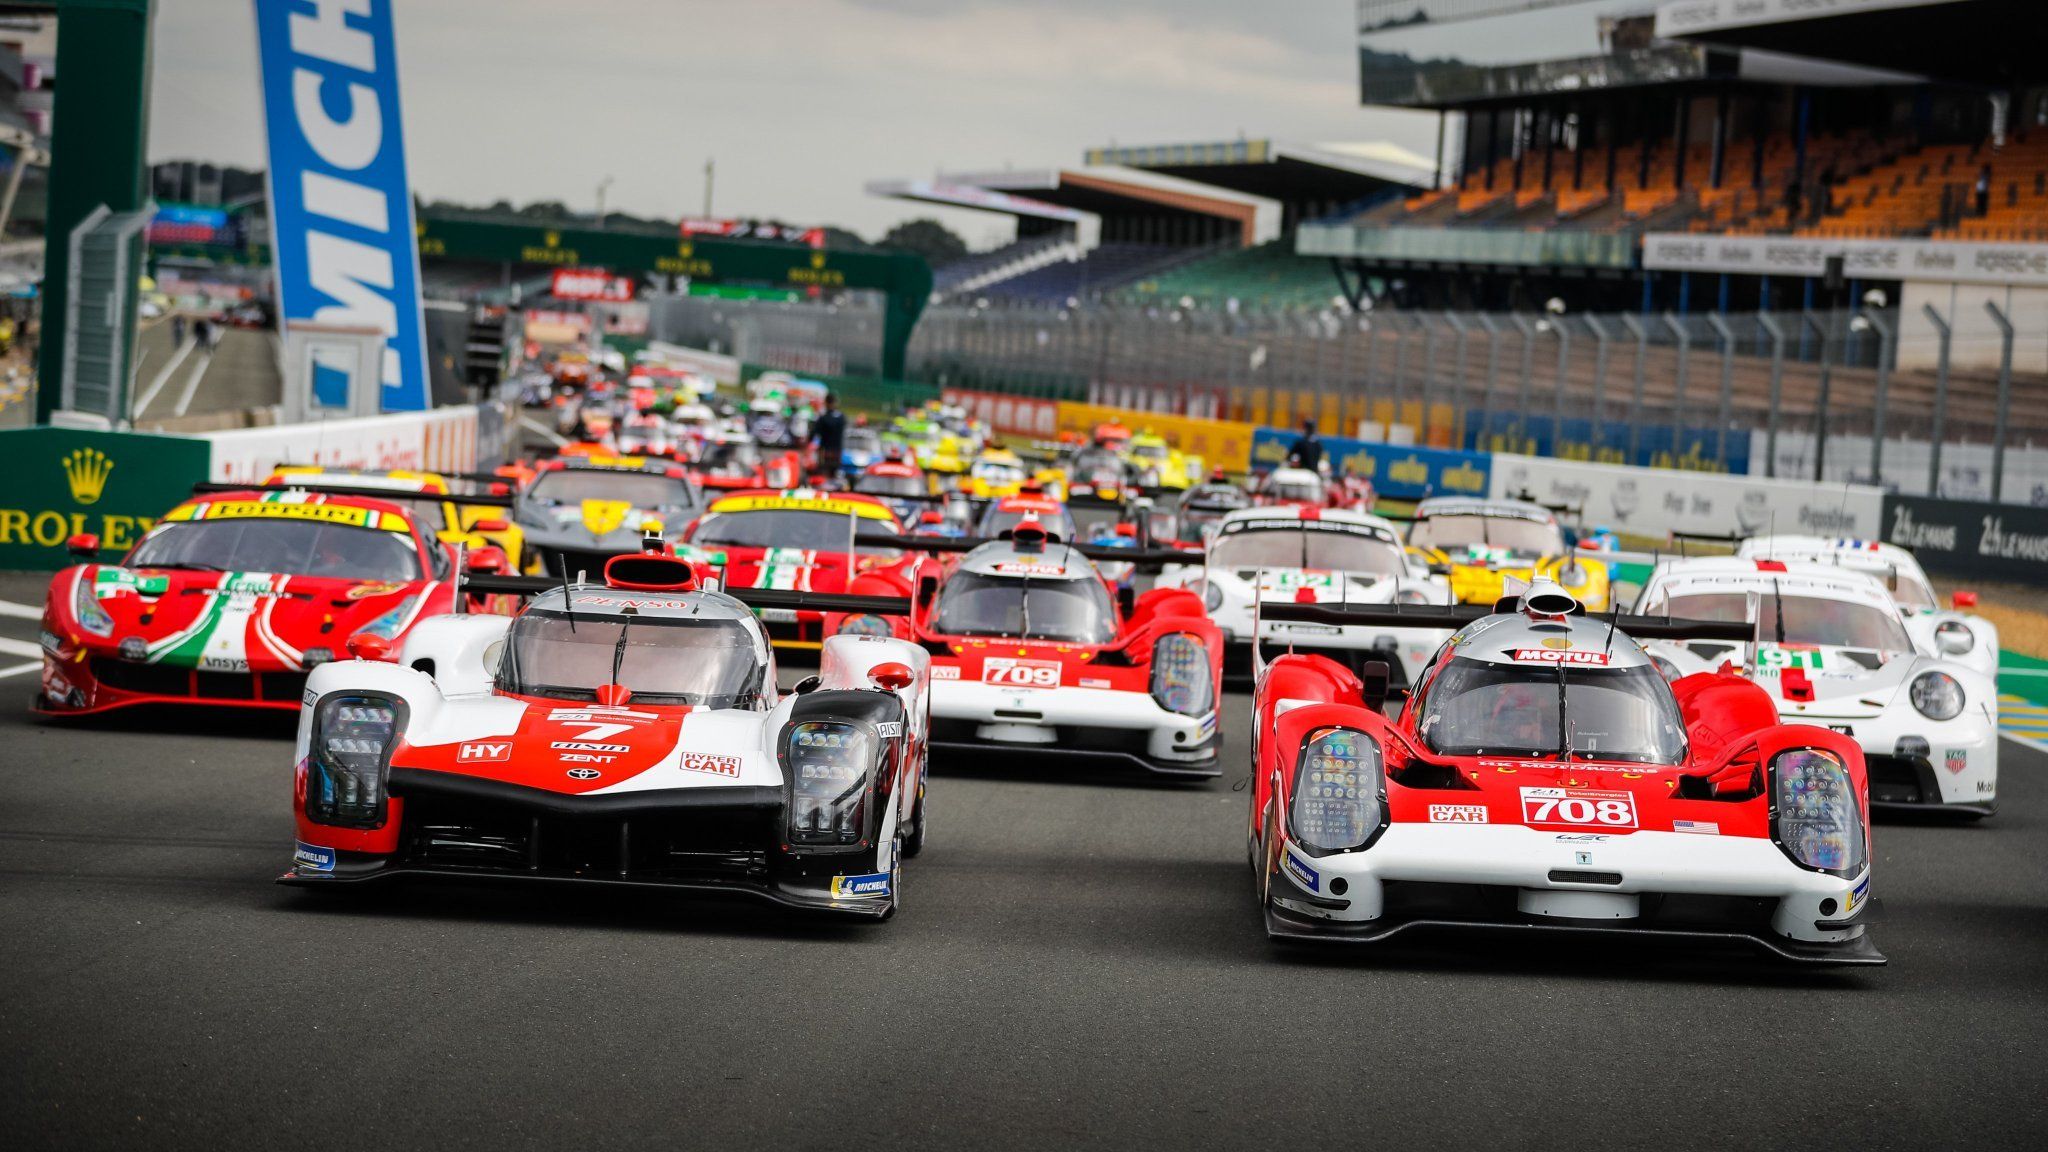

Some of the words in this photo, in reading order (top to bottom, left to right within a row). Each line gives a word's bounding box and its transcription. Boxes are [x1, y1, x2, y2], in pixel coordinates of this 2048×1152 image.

[220, 504, 362, 521] Ferrari
[999, 563, 1063, 575] MOTUL
[576, 595, 689, 610] DENSO
[1517, 650, 1605, 664] MOTUL
[1763, 648, 1812, 669] 91
[992, 665, 1060, 687] 709
[560, 721, 635, 741] 7
[461, 744, 509, 759] HY
[559, 753, 618, 764] ZENT
[685, 752, 738, 765] HYPER
[684, 758, 736, 776] CAR
[1432, 805, 1484, 813] HYPER
[1525, 797, 1633, 825] 708
[1432, 812, 1484, 822] CAR
